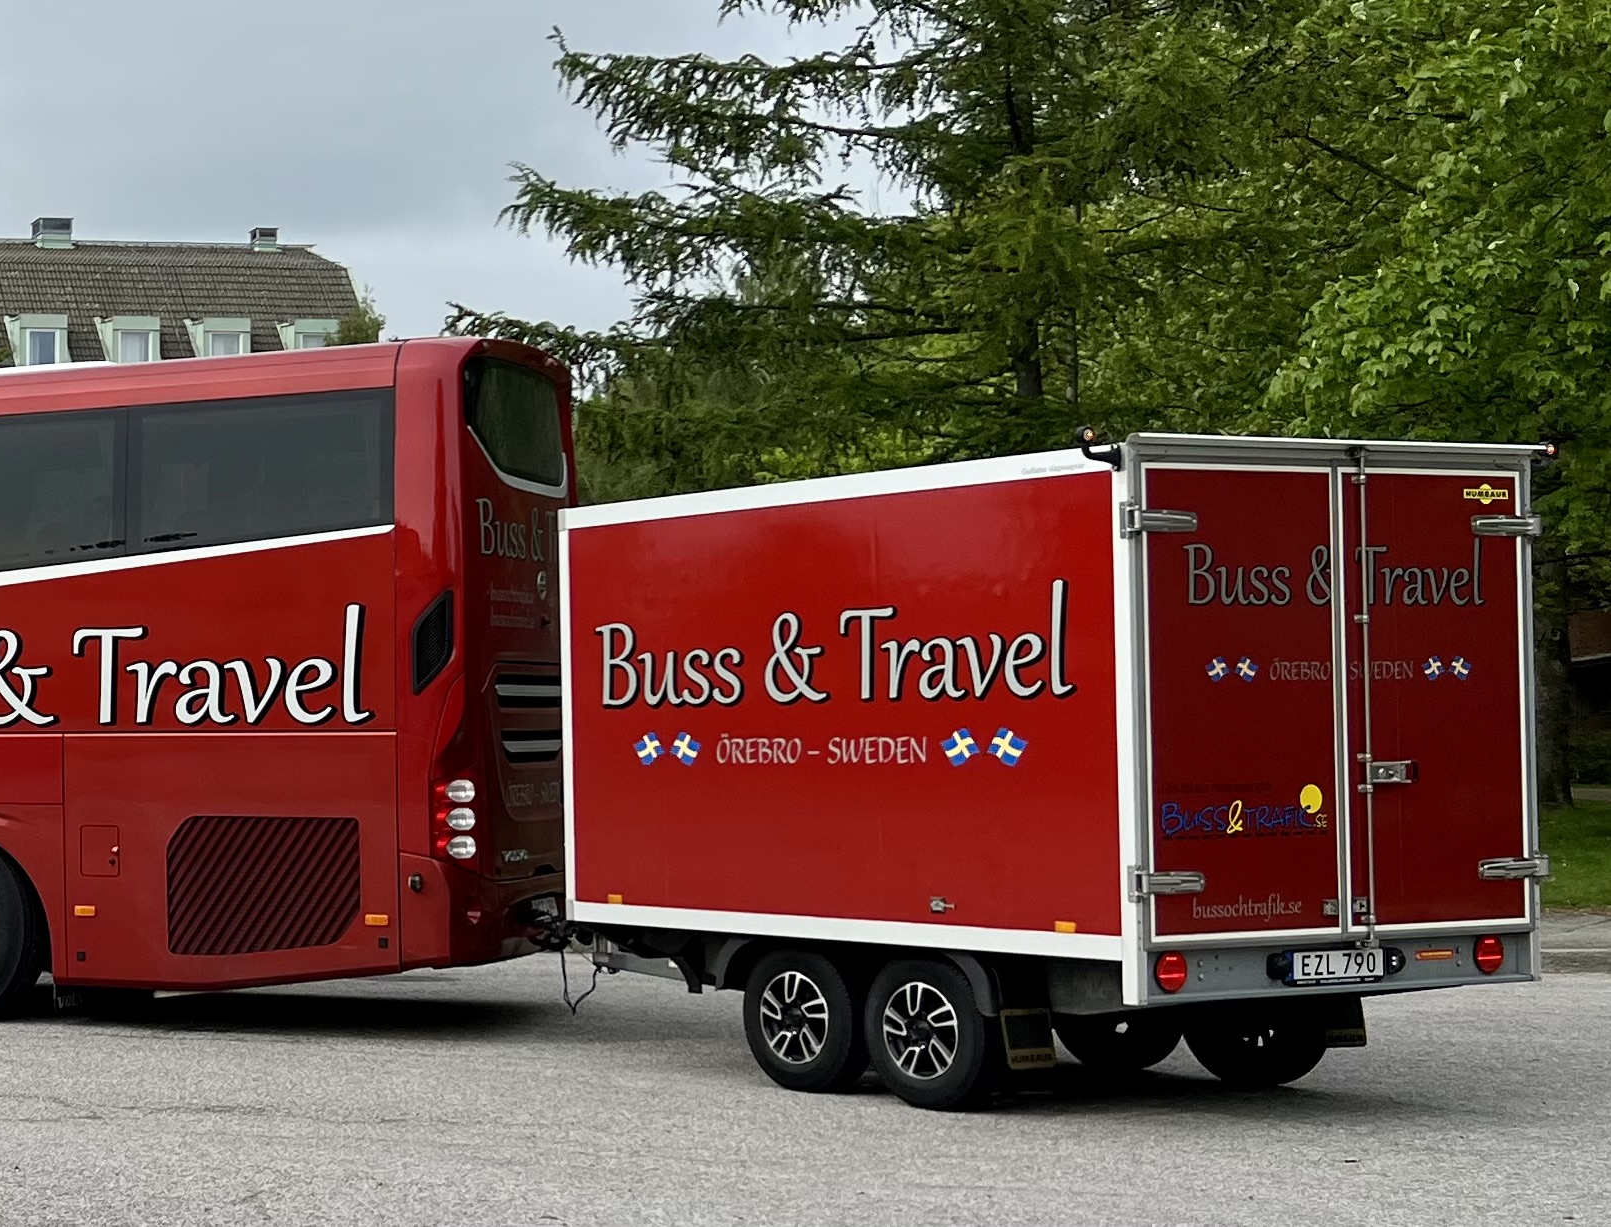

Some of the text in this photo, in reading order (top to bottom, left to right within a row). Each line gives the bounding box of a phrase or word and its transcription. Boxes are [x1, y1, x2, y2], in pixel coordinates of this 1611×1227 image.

[475, 497, 527, 560] Buss
[531, 507, 545, 562] &
[1182, 542, 1292, 606] Buss
[1354, 536, 1486, 606] Travel
[71, 602, 377, 727] Travel
[595, 577, 1076, 710] Buss & Travel
[1269, 657, 1332, 681] ÖREBRO
[715, 733, 802, 765] ÖREBRO
[827, 735, 928, 765] SWEDEN
[1192, 893, 1303, 922] bussochtrafik.se
[1301, 952, 1376, 976] EZL 790
